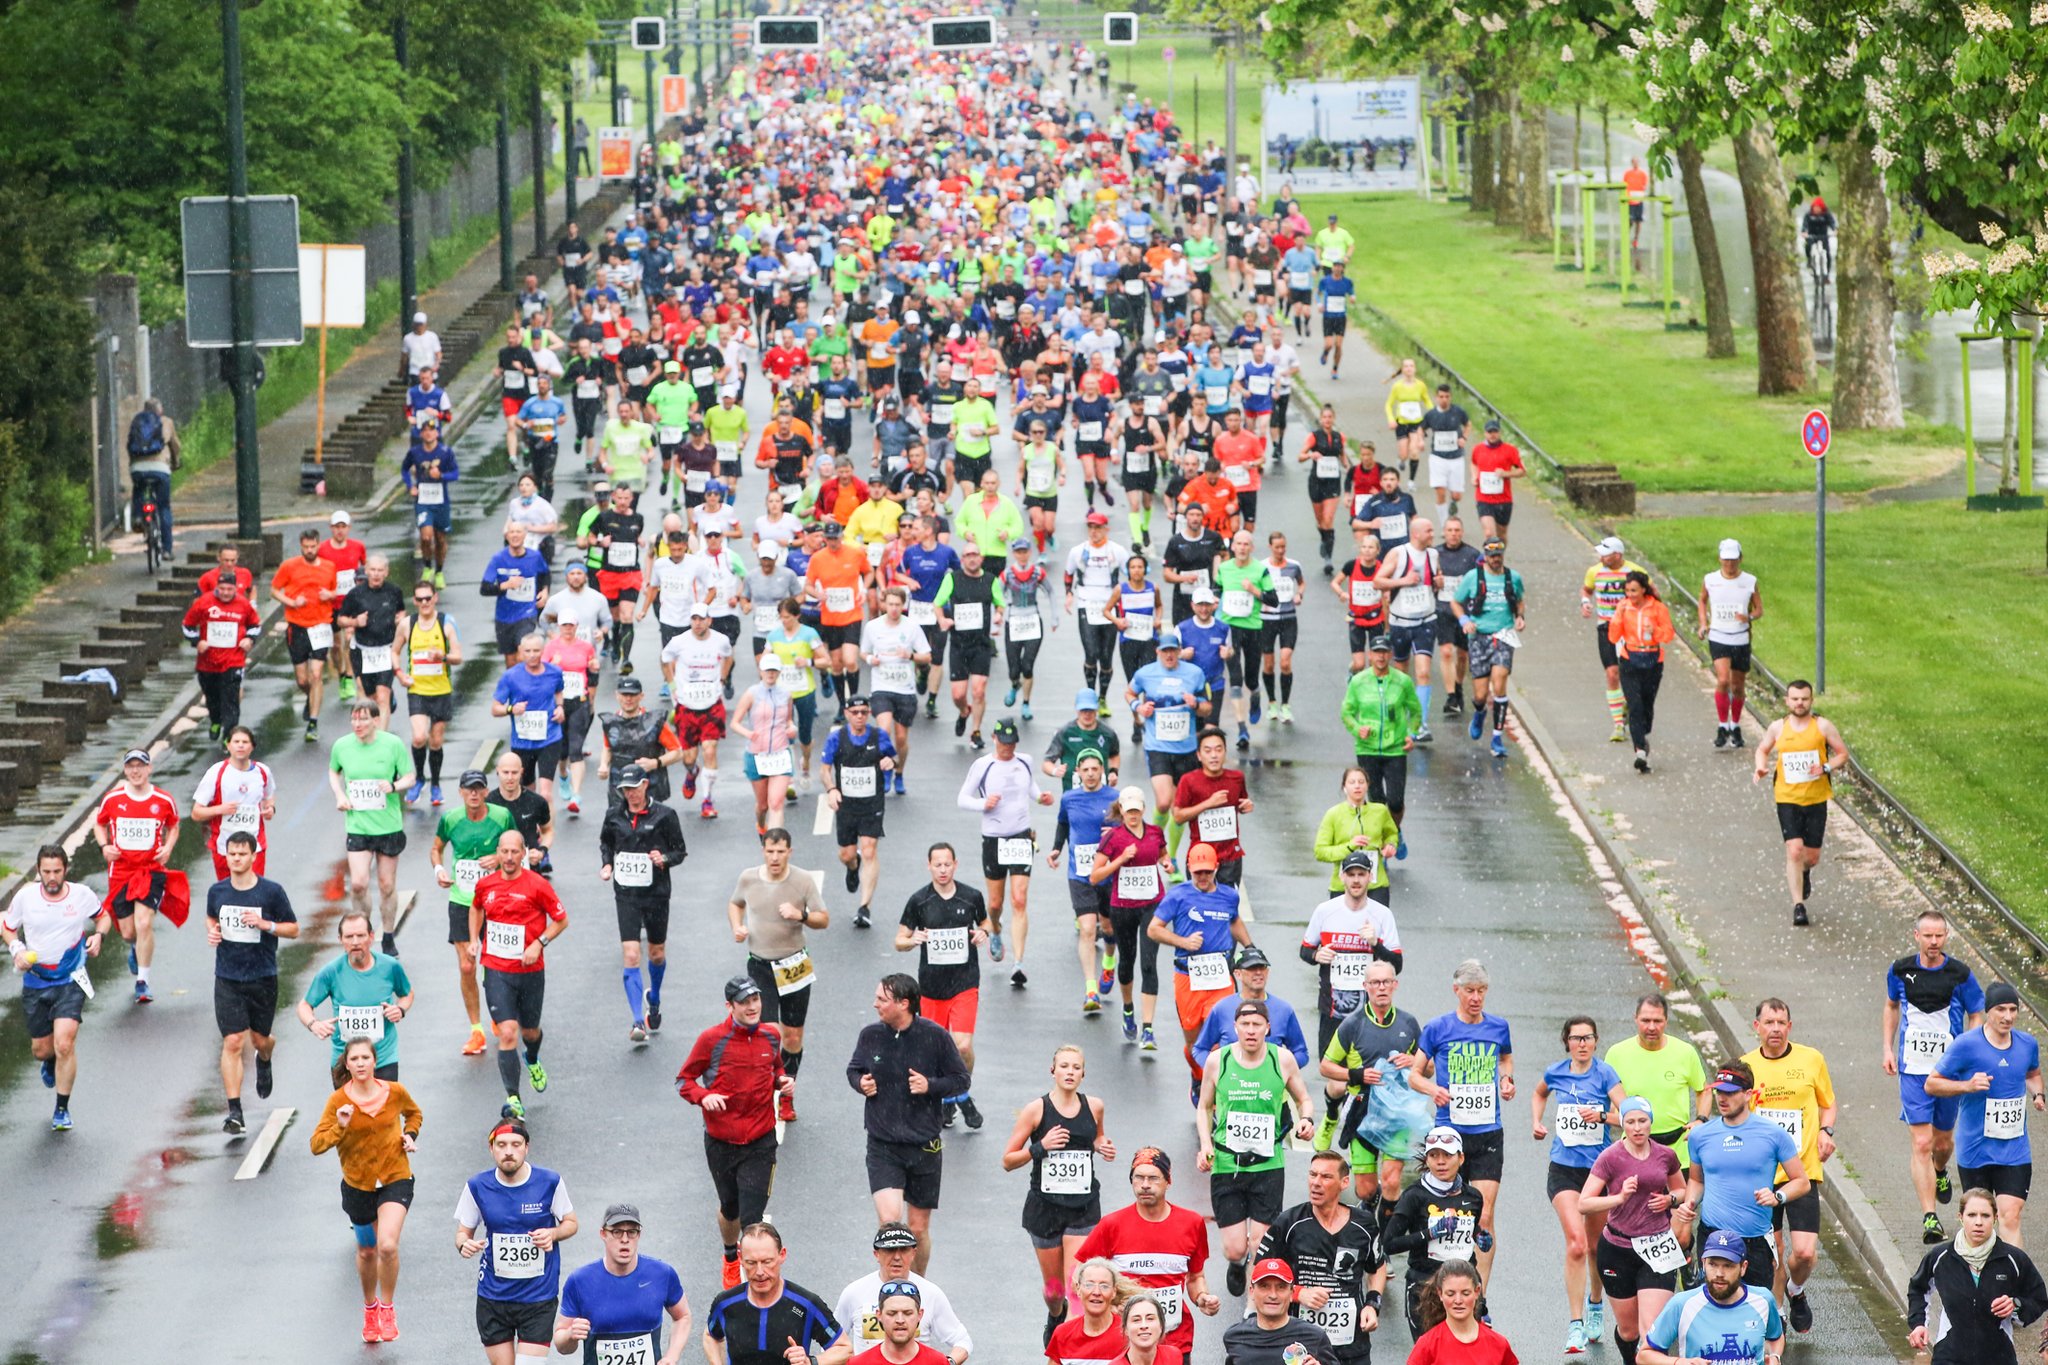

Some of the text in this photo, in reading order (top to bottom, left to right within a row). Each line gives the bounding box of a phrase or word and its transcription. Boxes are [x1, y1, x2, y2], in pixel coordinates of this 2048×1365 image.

[1161, 721, 1187, 730] 3407
[845, 775, 872, 786] 2684
[353, 789, 381, 799] 3166
[1204, 816, 1232, 829] 3804
[121, 827, 151, 838] 3583
[619, 862, 647, 874] 2512
[1123, 876, 1154, 887] 3828
[491, 931, 519, 945] 2188
[932, 938, 965, 951] 3306
[784, 962, 806, 980] 222
[1193, 963, 1225, 976] 3393
[1336, 964, 1367, 976] 1455
[344, 1018, 377, 1030] 1881
[1911, 1040, 1945, 1053] 1371
[1239, 1079, 1260, 1088] Team
[1456, 1096, 1491, 1109] 2985
[1235, 1114, 1270, 1123] METRO
[1992, 1109, 2022, 1124] 1335
[1233, 1124, 1268, 1140] 3621
[1048, 1163, 1085, 1177] 3391
[499, 1247, 540, 1262] 2369
[1642, 1237, 1677, 1260] 1853
[1306, 1310, 1350, 1328] 3023
[605, 1338, 645, 1350] METRO
[604, 1350, 646, 1365] 2247
